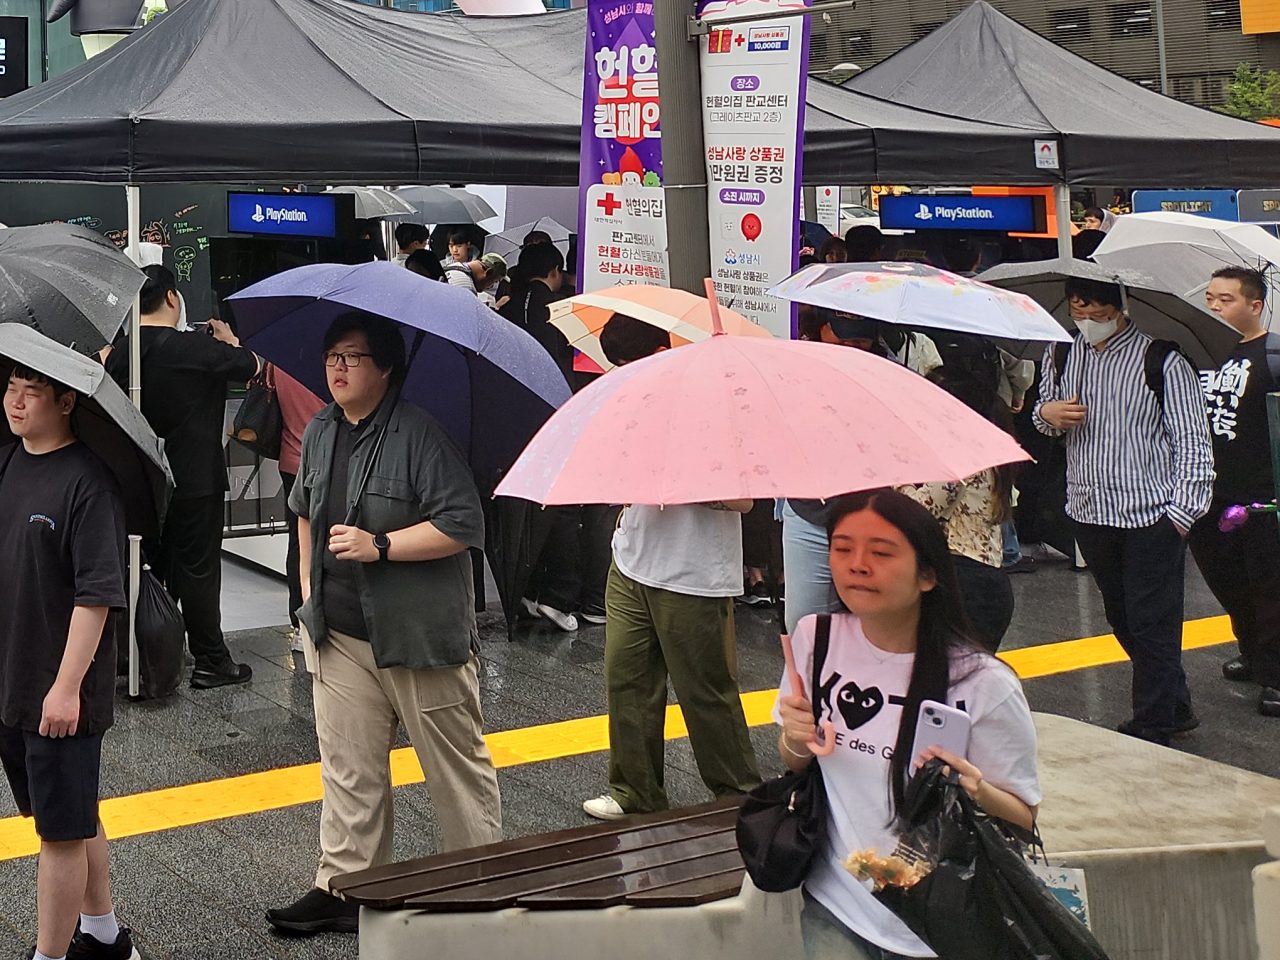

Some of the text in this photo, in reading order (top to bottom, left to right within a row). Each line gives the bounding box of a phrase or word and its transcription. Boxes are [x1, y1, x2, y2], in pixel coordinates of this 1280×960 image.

[736, 78, 755, 90] 장소
[706, 95, 788, 108] 헌혈의집 판교센터
[763, 111, 782, 123] 2층)
[707, 146, 785, 162] 성남사랑 상품권
[709, 164, 784, 184] 1만원권 증정
[723, 191, 760, 203] 소진 시까지
[266, 207, 308, 224] PlayStation
[625, 198, 663, 218] 헌혈의집
[934, 206, 994, 221] PlayStation
[738, 252, 761, 265] 성남시
[717, 268, 769, 283] 성남사랑 상품권은
[849, 738, 876, 755] des
